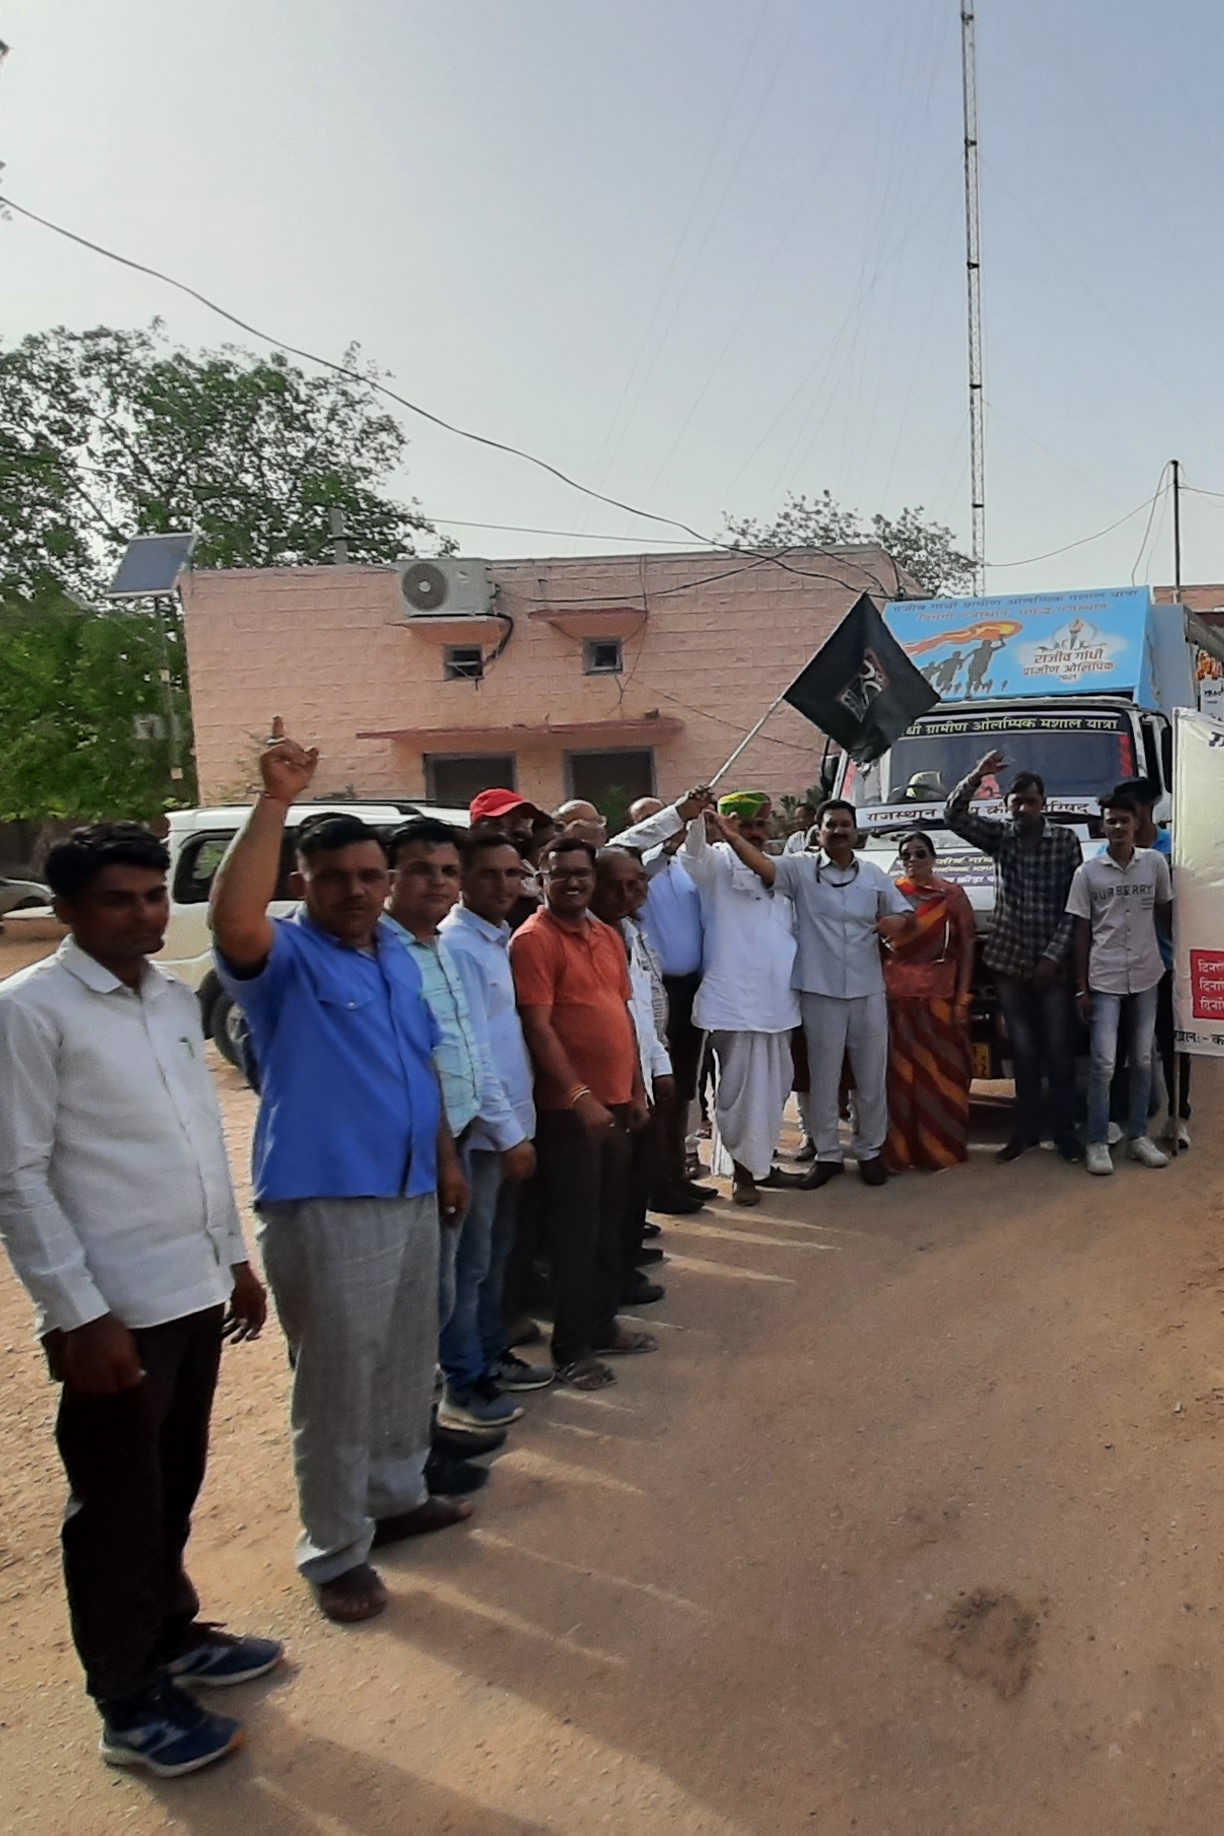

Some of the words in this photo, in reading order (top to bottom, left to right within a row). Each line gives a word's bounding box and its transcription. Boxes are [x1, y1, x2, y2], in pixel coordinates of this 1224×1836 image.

[1034, 650, 1072, 664] राजीव
[926, 720, 968, 735] ग्रामीण
[1041, 718, 1082, 730] मशाल
[1085, 718, 1119, 730] यात्रा
[865, 808, 938, 823] राजस्थान
